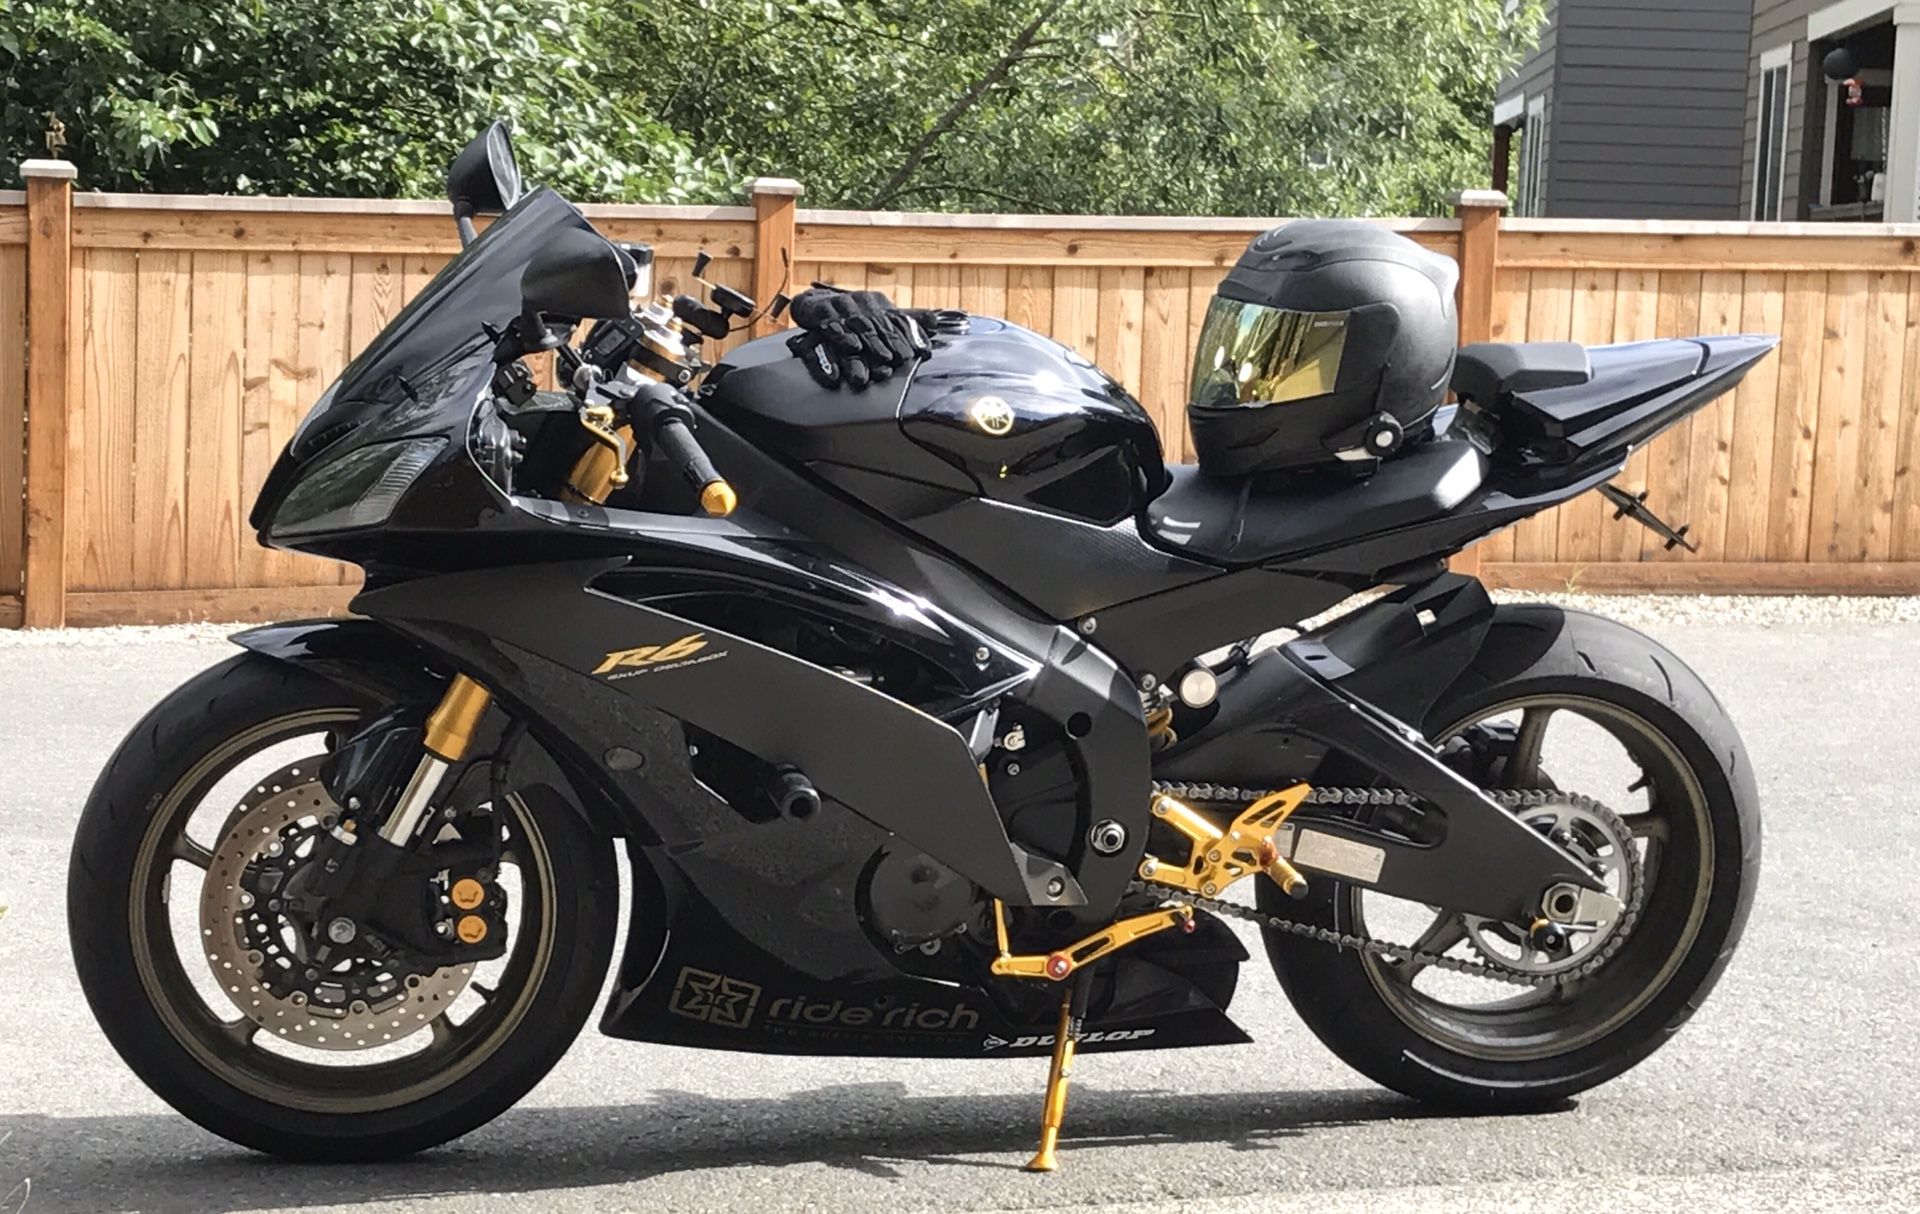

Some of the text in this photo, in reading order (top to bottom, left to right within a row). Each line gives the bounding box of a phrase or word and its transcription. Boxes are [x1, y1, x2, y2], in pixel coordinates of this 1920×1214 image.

[591, 632, 708, 675] R6
[768, 995, 980, 1030] ride rich
